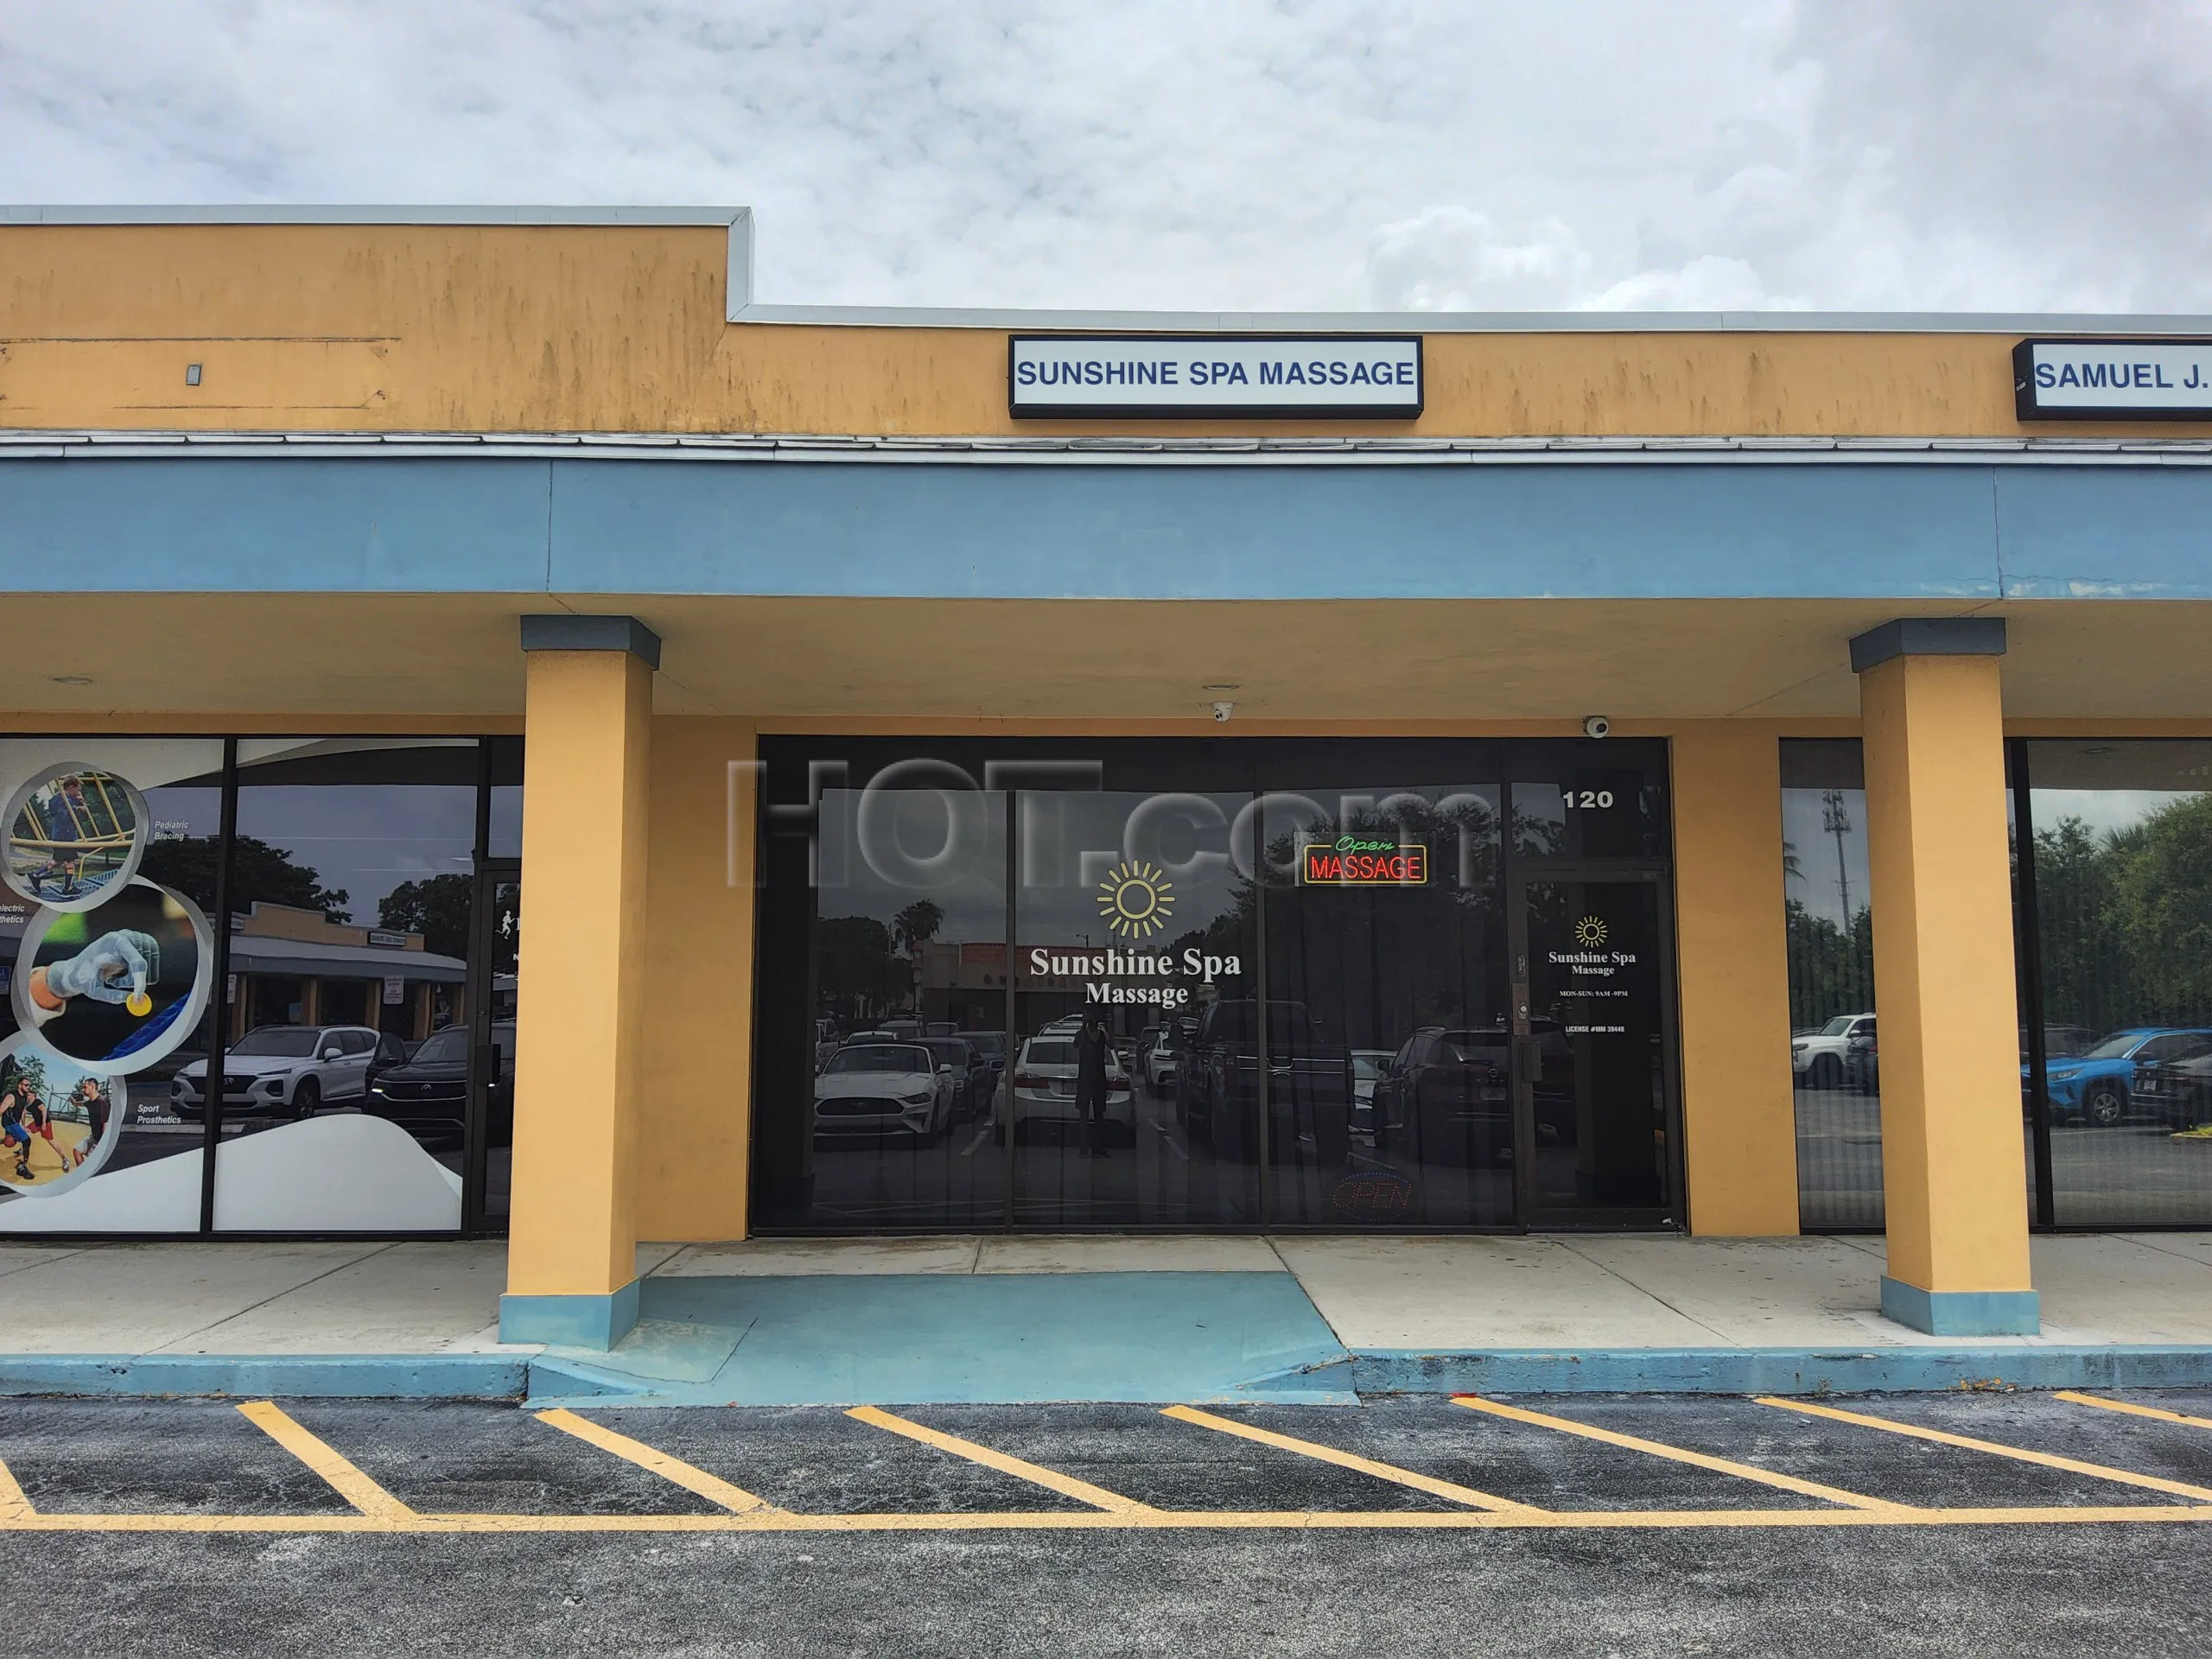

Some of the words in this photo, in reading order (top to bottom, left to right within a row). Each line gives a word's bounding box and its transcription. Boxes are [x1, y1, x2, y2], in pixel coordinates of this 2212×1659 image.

[1017, 361, 1179, 385] SUNSHINE
[1189, 361, 1249, 385] SPA
[1259, 361, 1414, 385] MASSAGE
[2035, 363, 2174, 389] SAMUEL
[2183, 364, 2209, 389] J.
[1562, 791, 1614, 809] 120
[154, 820, 189, 830] Pediatric
[154, 832, 185, 842] Bracing
[1335, 836, 1395, 855] Open
[1311, 855, 1421, 880] MASSAGE
[1030, 948, 1173, 976] Sunshine
[1183, 948, 1242, 983] Spa
[1548, 951, 1609, 963] Sunshine
[1611, 951, 1637, 966] Spa
[1572, 965, 1615, 977] Massage
[1084, 982, 1189, 1009] Massage
[137, 1104, 160, 1115] Sport
[137, 1116, 181, 1124] Prosthetics
[1332, 1182, 1412, 1208] OPEN
